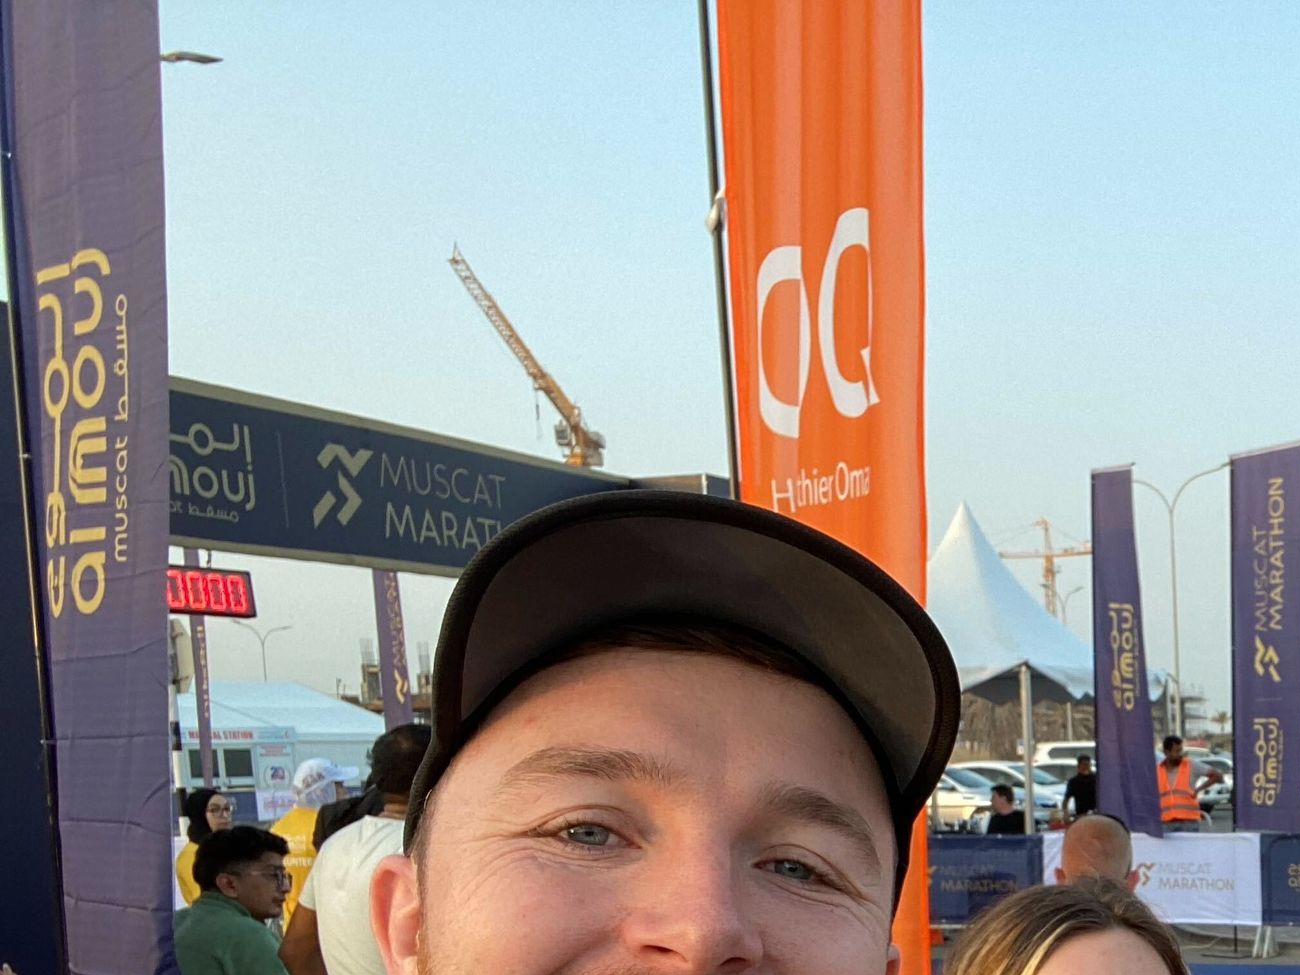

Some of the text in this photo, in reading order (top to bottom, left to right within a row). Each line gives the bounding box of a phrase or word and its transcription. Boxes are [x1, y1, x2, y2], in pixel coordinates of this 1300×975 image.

[114, 294, 128, 422] مسقط
[757, 207, 880, 439] OQ
[115, 436, 129, 562] muscat
[380, 453, 506, 509] MUSCAT
[384, 503, 502, 552] MARAT
[1268, 477, 1285, 630] MARATHON
[1252, 526, 1268, 632] MUSCAT
[224, 730, 254, 740] STATION
[1158, 863, 1212, 874] MUSCAT
[1158, 877, 1235, 891] MARATHON
